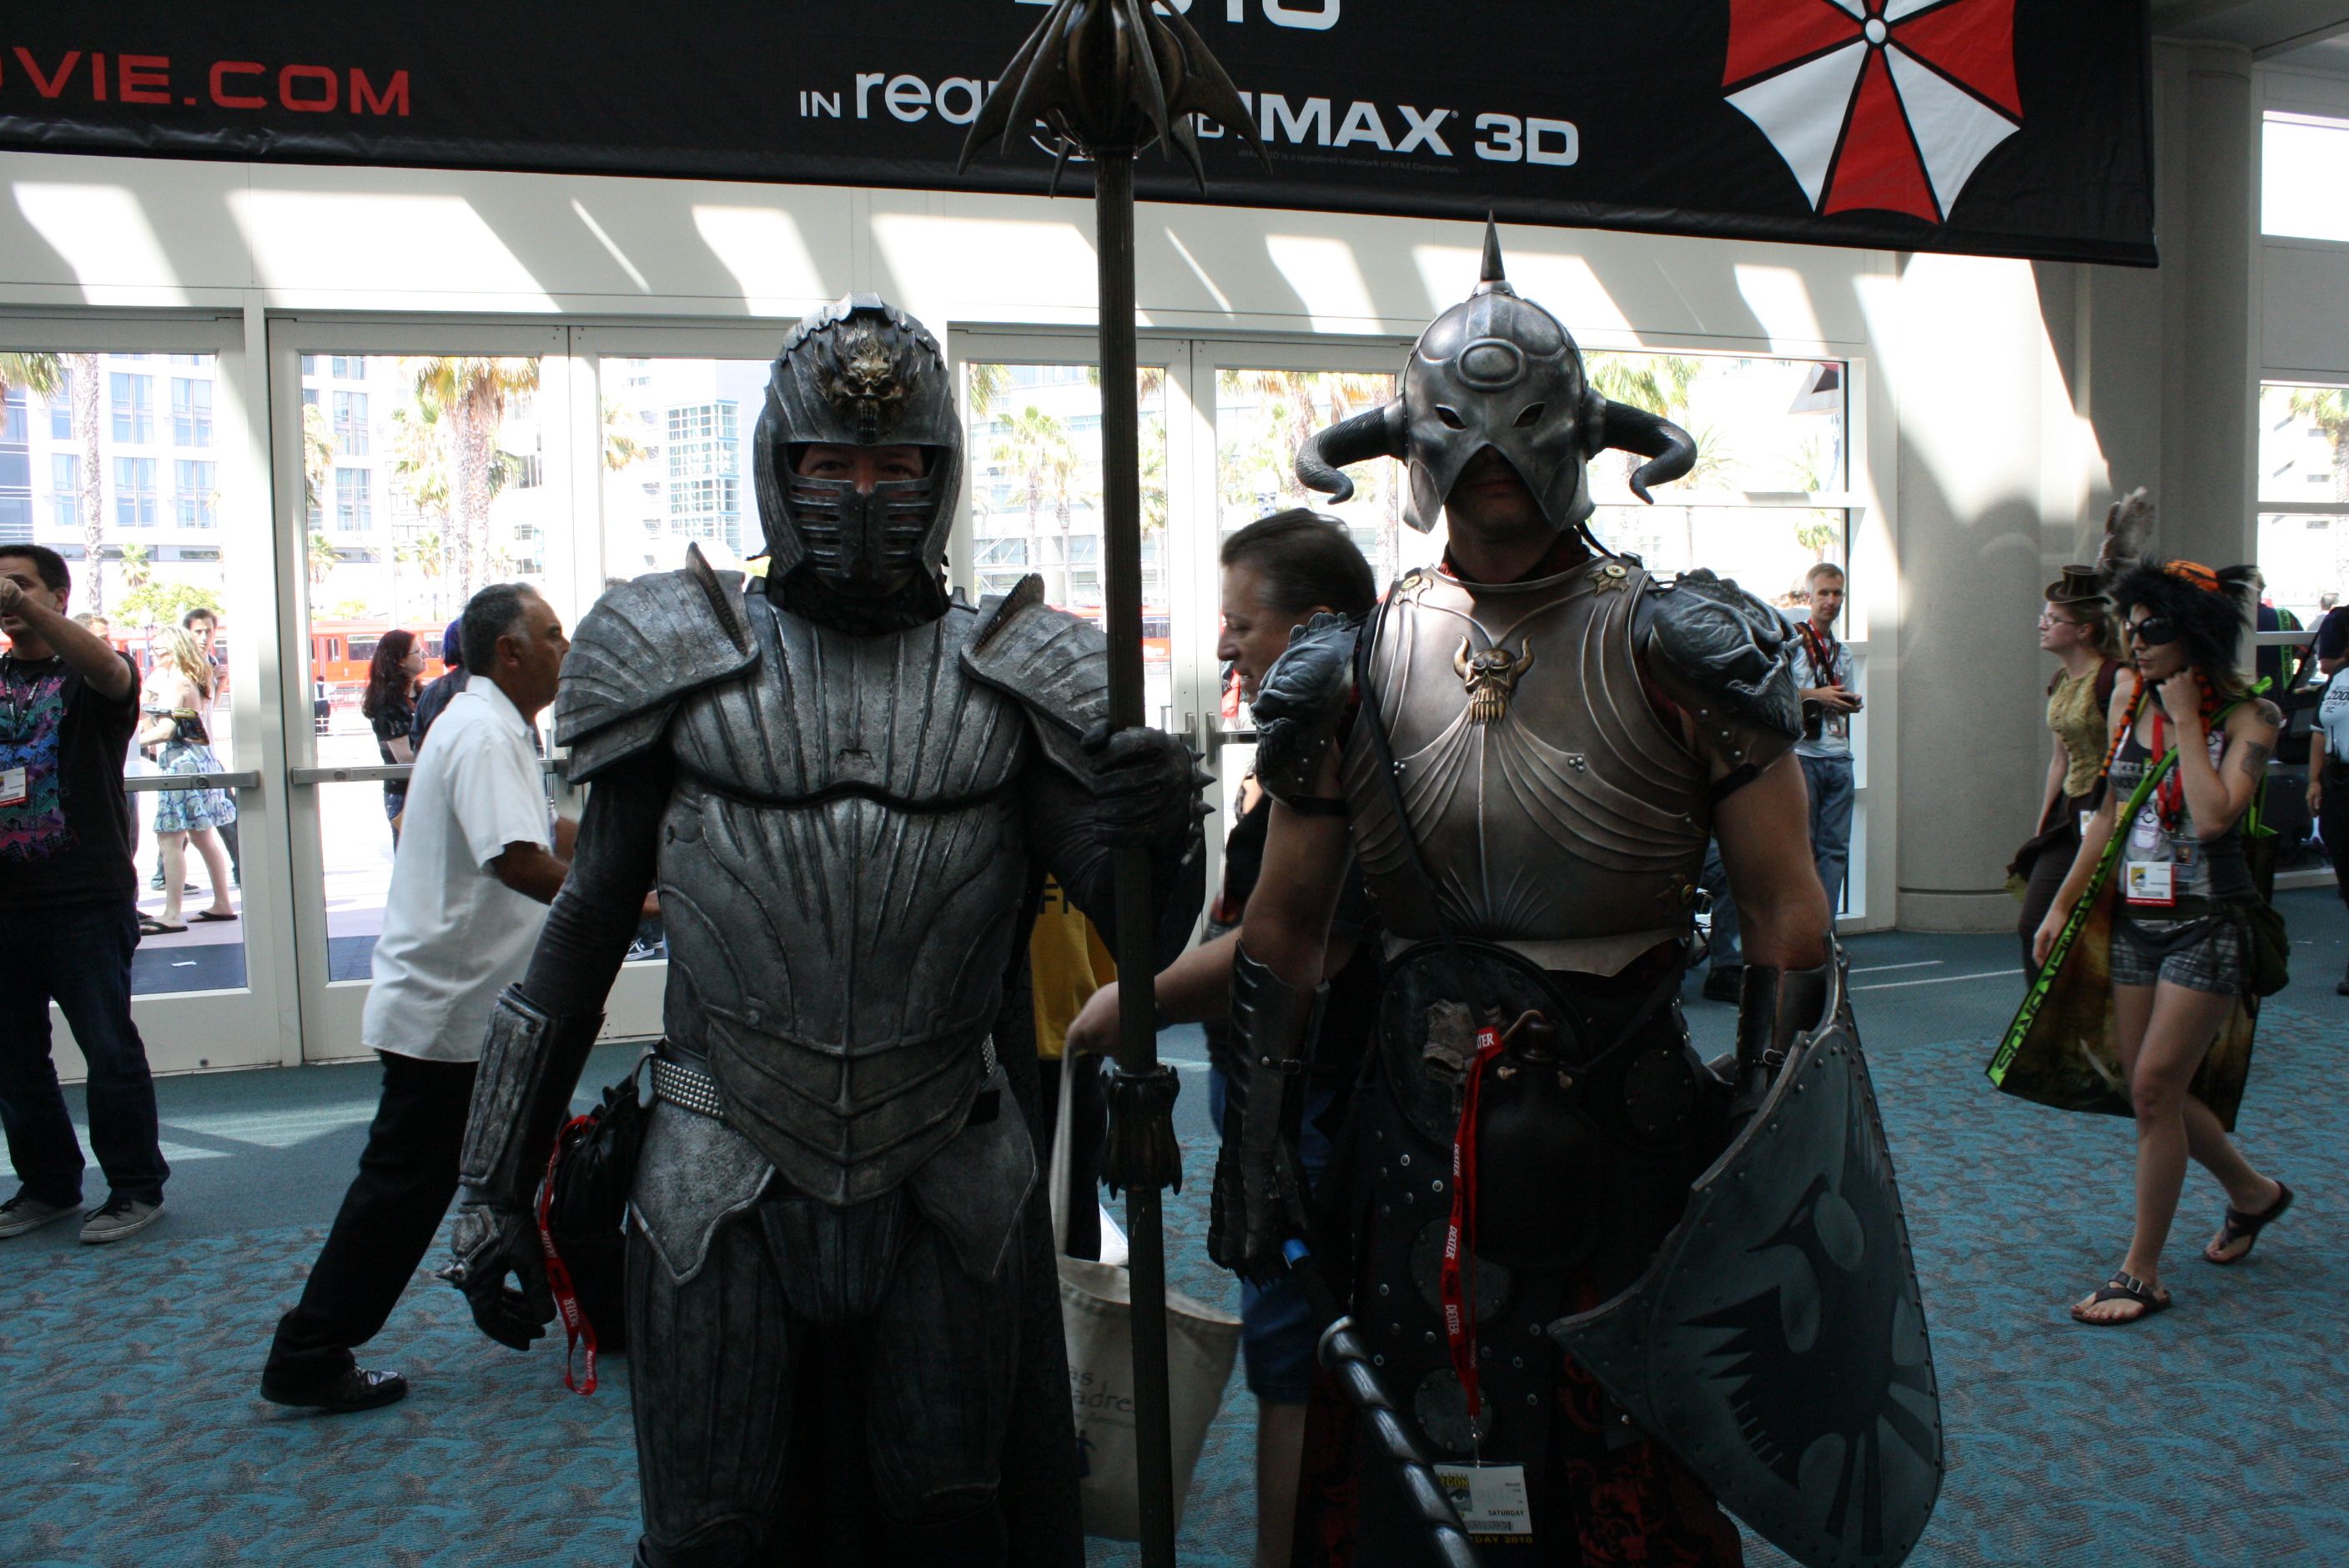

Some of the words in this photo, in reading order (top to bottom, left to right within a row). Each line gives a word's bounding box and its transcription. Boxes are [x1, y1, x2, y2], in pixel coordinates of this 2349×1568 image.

[0, 47, 410, 116] VIE.COM
[799, 89, 841, 118] IN
[856, 73, 999, 125] rea
[1474, 113, 1579, 167] 3D
[1297, 153, 1338, 165] registered
[1339, 157, 1379, 167] trademark
[1390, 161, 1411, 171] IMAX
[1412, 163, 1459, 173] Corporation
[2326, 690, 2349, 701] 200
[1445, 1224, 1458, 1259] DEXTER
[563, 1296, 580, 1328] DEXTER
[1445, 1304, 1460, 1335] DEXTER
[1488, 1509, 1525, 1517] SATURDAY
[1473, 1535, 1501, 1545] DAY
[1503, 1535, 1534, 1545] 2010
